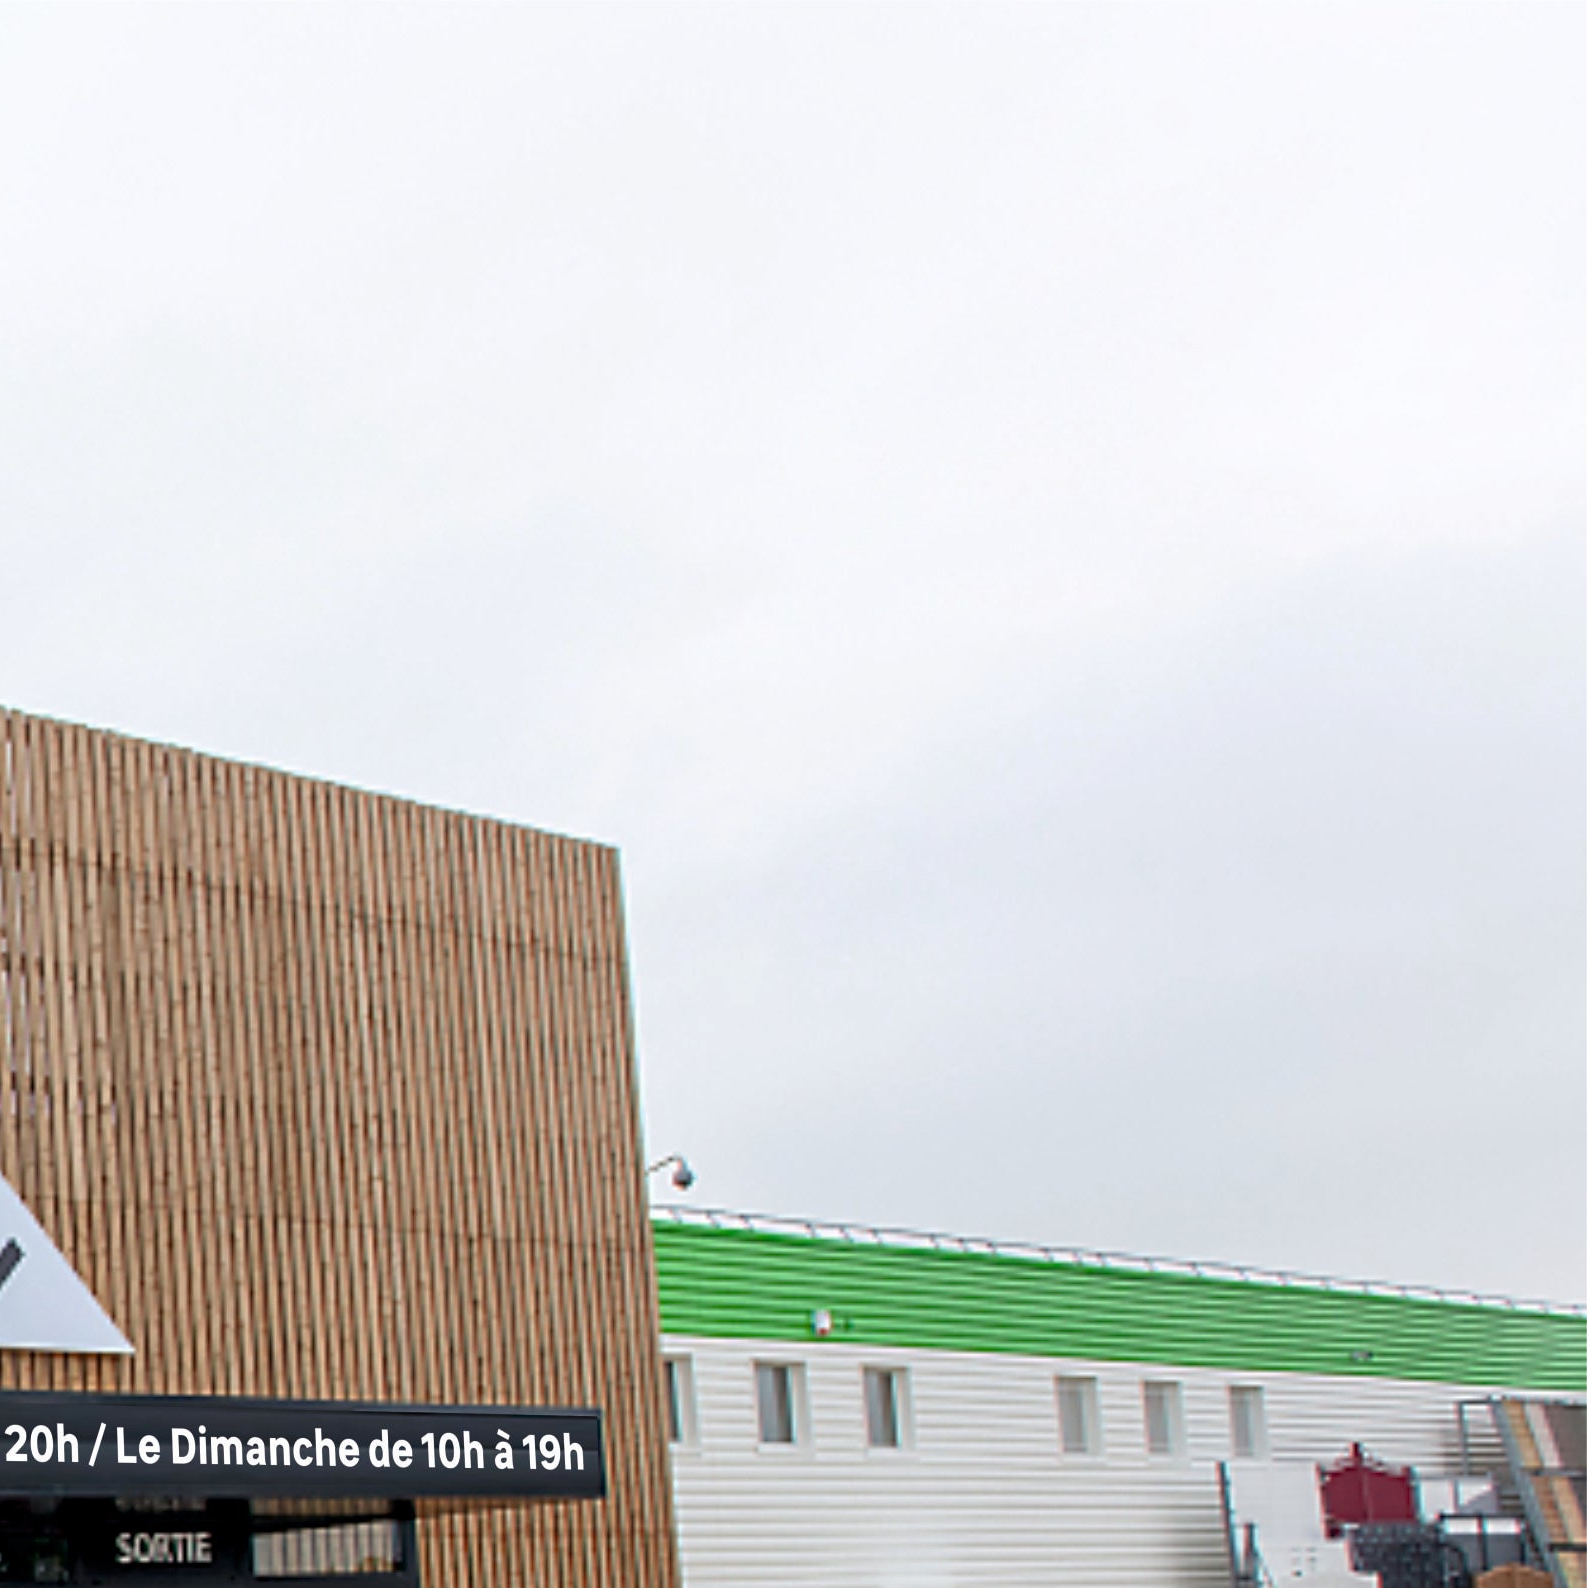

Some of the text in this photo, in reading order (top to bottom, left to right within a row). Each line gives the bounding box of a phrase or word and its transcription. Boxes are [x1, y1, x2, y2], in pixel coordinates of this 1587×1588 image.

[4, 1422, 79, 1463] 20h
[116, 1426, 161, 1465] Le
[171, 1424, 360, 1468] Dimanche
[368, 1428, 413, 1469] de
[420, 1430, 485, 1469] 10h
[494, 1428, 515, 1470] à
[522, 1432, 585, 1471] 19h
[114, 1532, 213, 1564] SORTIE
